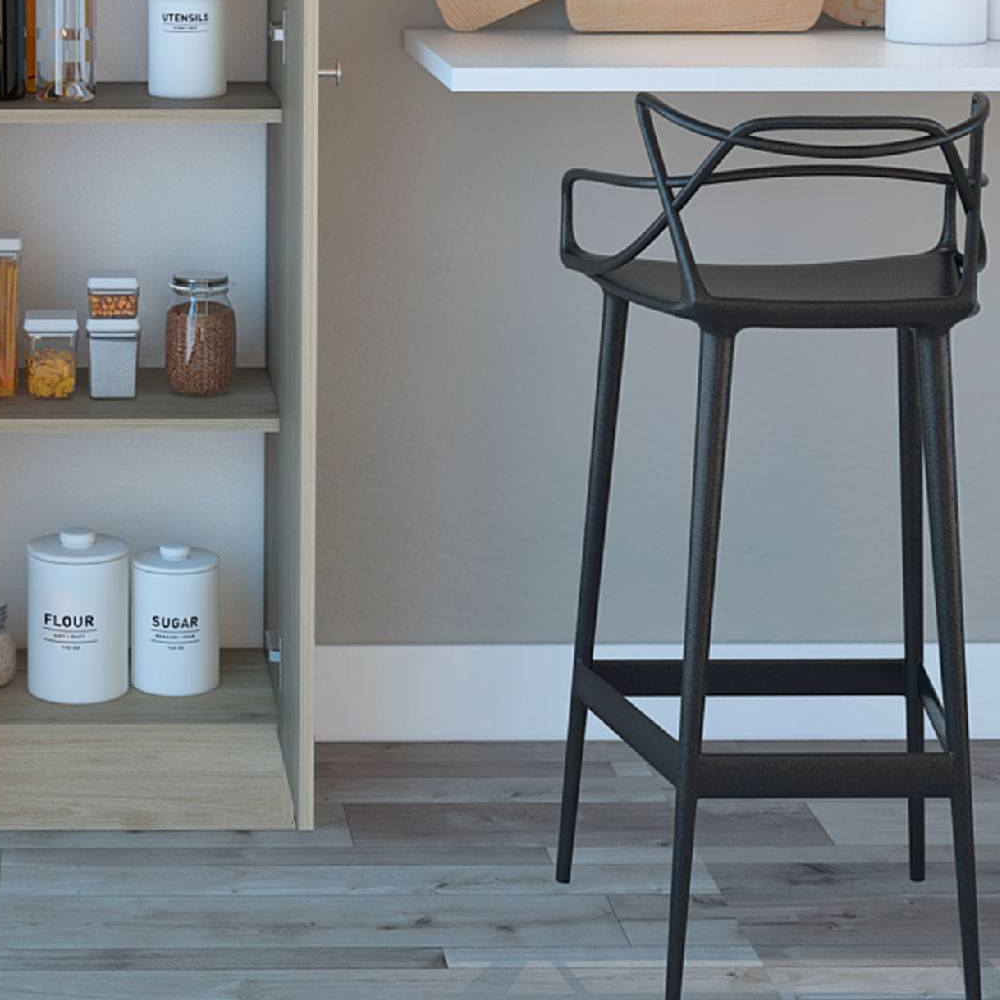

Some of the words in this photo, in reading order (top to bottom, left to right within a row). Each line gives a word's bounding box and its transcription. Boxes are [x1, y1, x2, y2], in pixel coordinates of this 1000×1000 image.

[161, 12, 209, 22] UTENSILS
[44, 613, 95, 628] FLOUR
[152, 615, 199, 629] SUGAR
